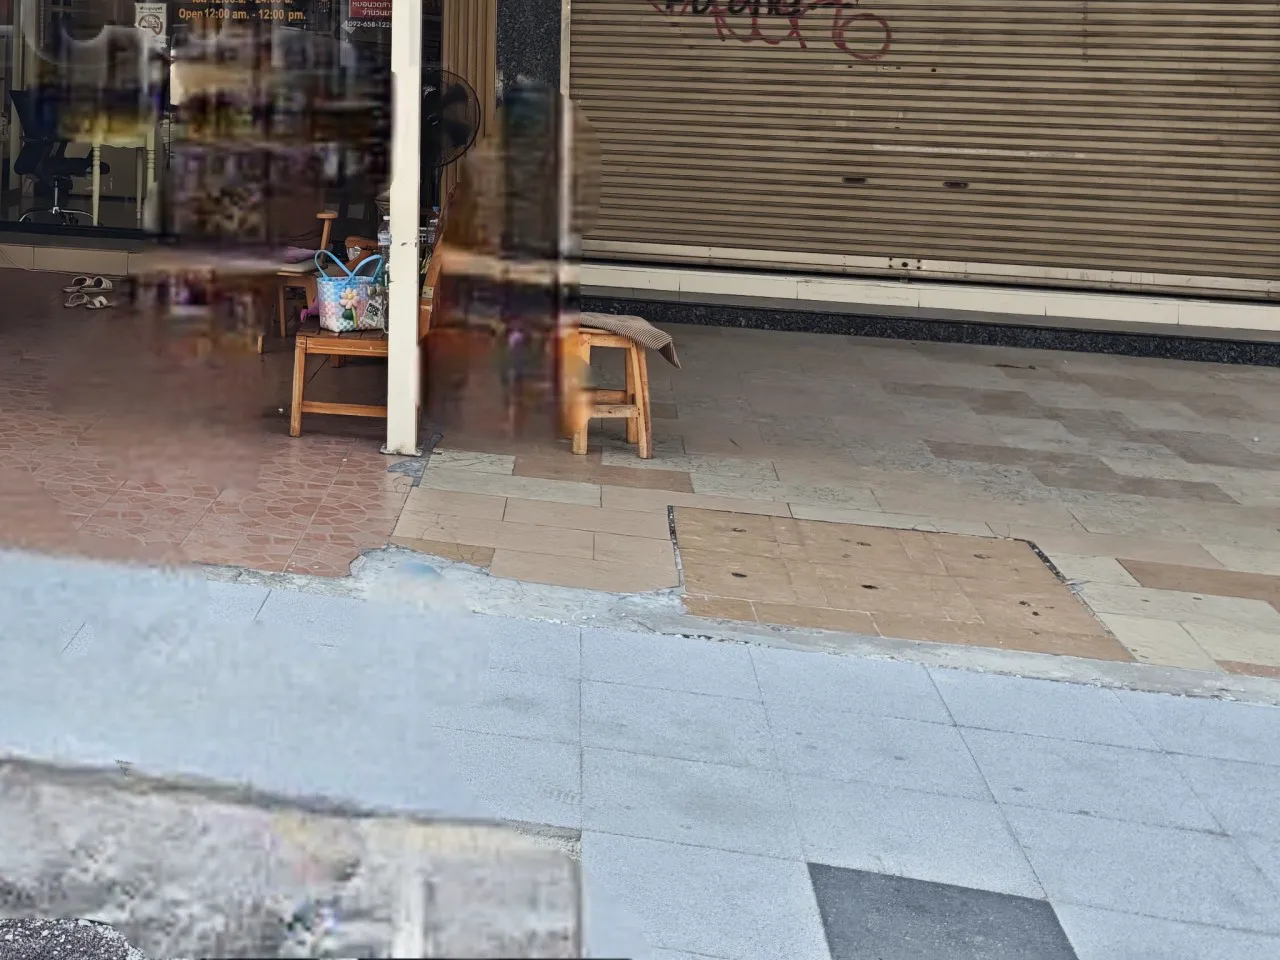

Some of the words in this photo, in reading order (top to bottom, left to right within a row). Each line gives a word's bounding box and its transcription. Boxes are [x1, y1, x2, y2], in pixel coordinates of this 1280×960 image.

[178, 8, 202, 19] Open
[204, 8, 230, 19] 12:00
[232, 10, 250, 19] am.
[258, 9, 285, 20] 12:00
[288, 10, 306, 22] pm.
